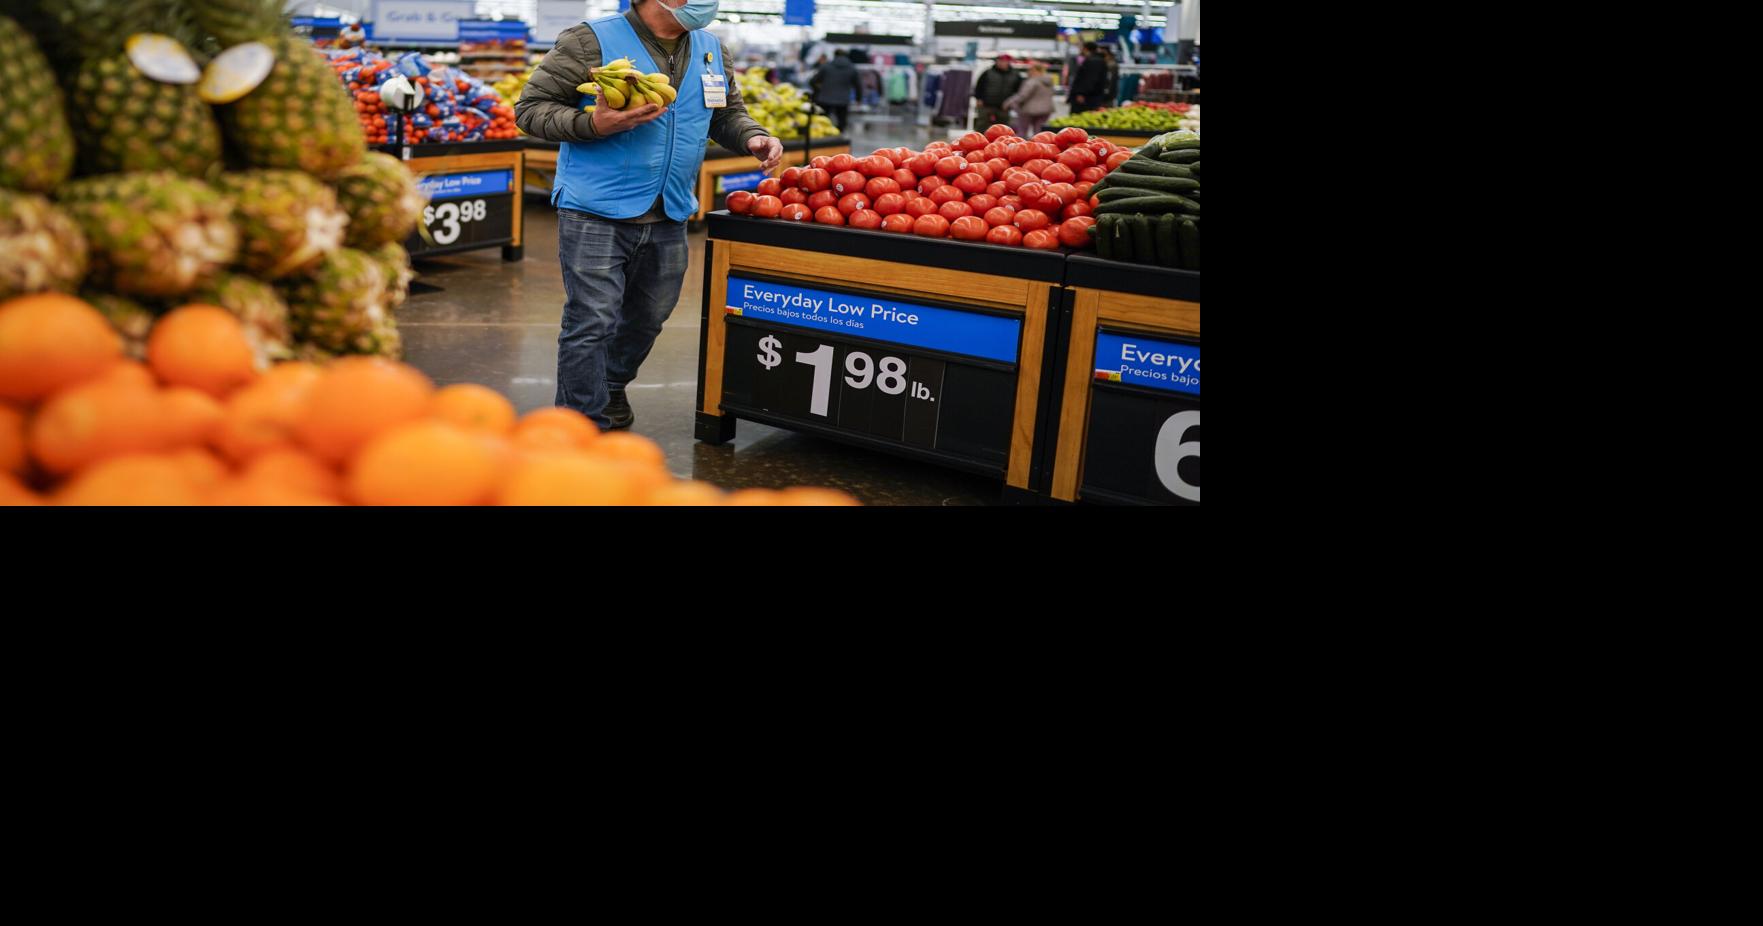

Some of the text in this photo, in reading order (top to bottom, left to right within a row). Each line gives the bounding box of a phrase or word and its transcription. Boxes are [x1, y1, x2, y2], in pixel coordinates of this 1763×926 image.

[743, 284, 919, 325] Everyday Low Price
[743, 302, 865, 329] Precios bajos todos los días
[1120, 364, 1167, 380] Precios
[1154, 410, 1200, 502] 6
